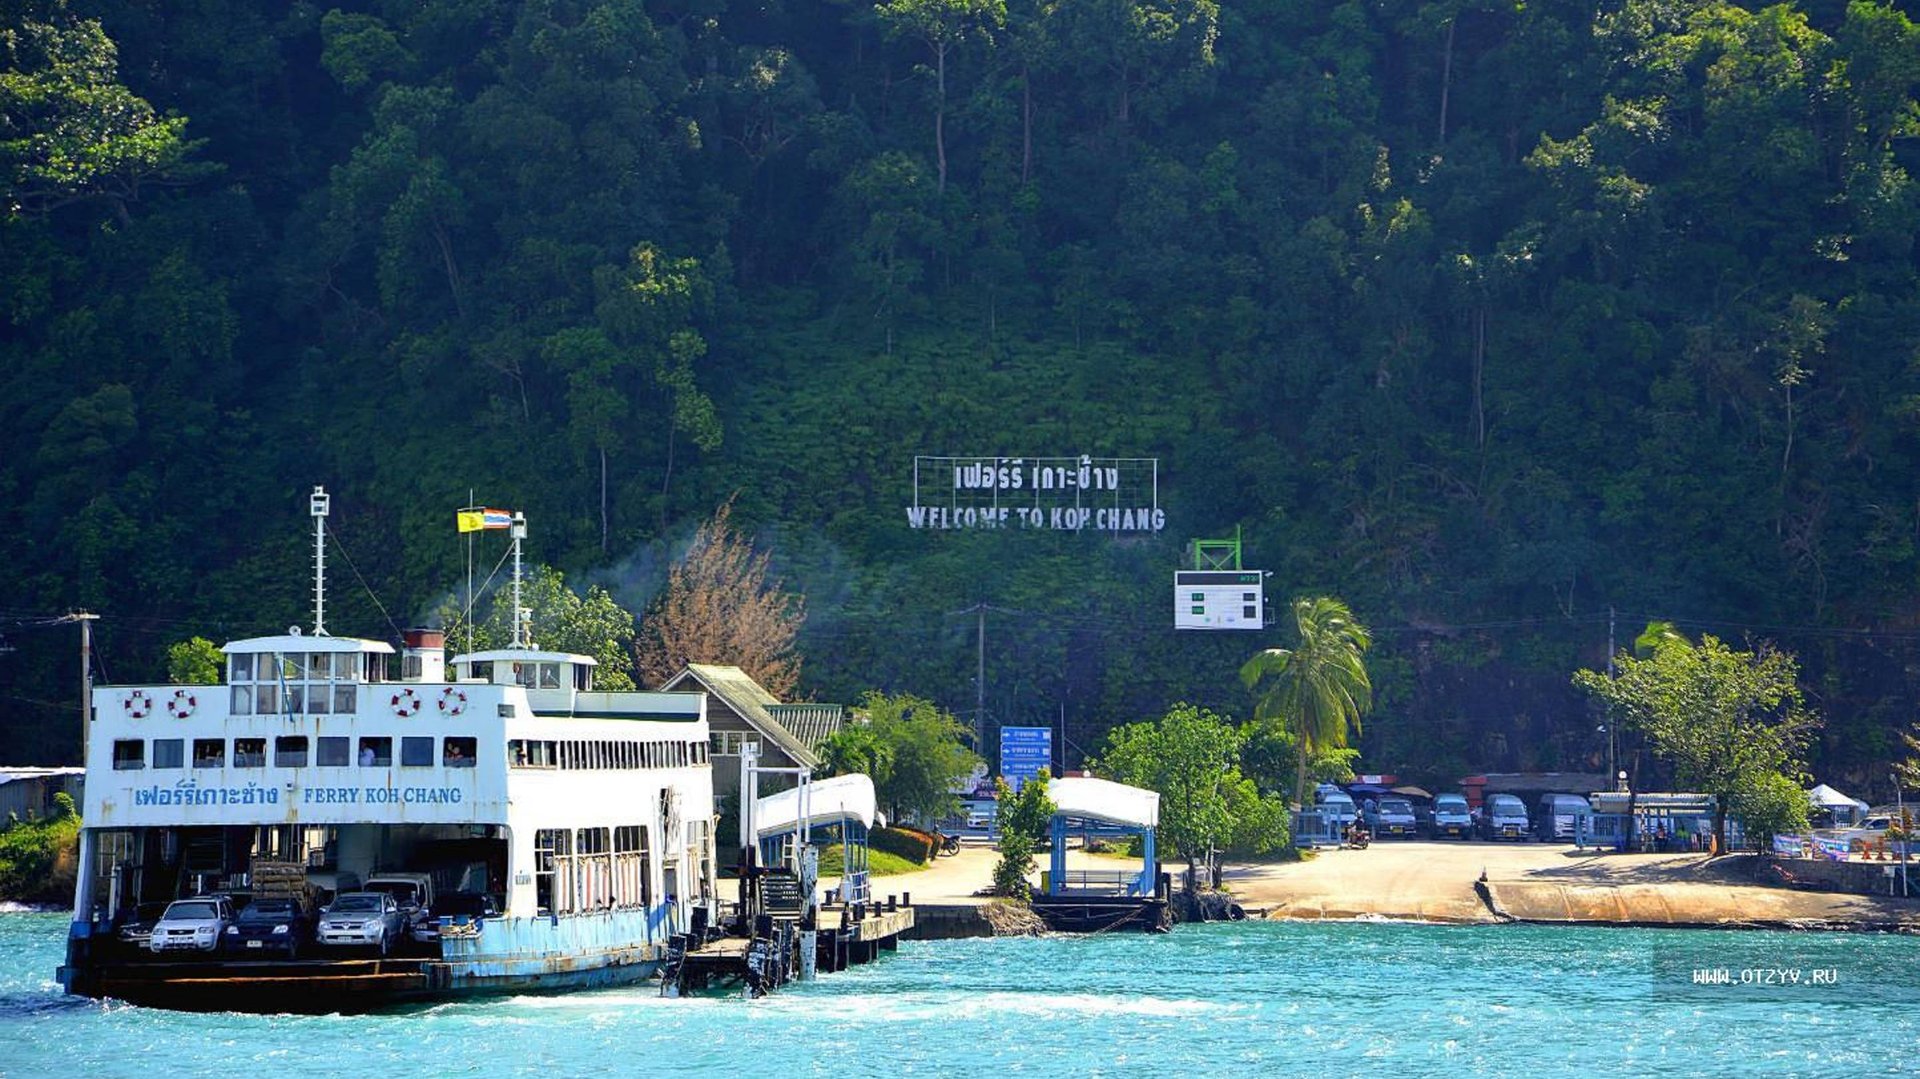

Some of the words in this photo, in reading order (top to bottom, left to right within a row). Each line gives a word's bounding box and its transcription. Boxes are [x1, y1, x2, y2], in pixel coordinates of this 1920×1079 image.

[906, 507, 1009, 529] WELCOME
[1017, 507, 1043, 529] TO
[1050, 507, 1091, 530] KOH
[1097, 508, 1165, 530] CHANG
[304, 787, 360, 804] FERRY
[365, 787, 399, 804] KOH
[403, 787, 462, 804] CHANG
